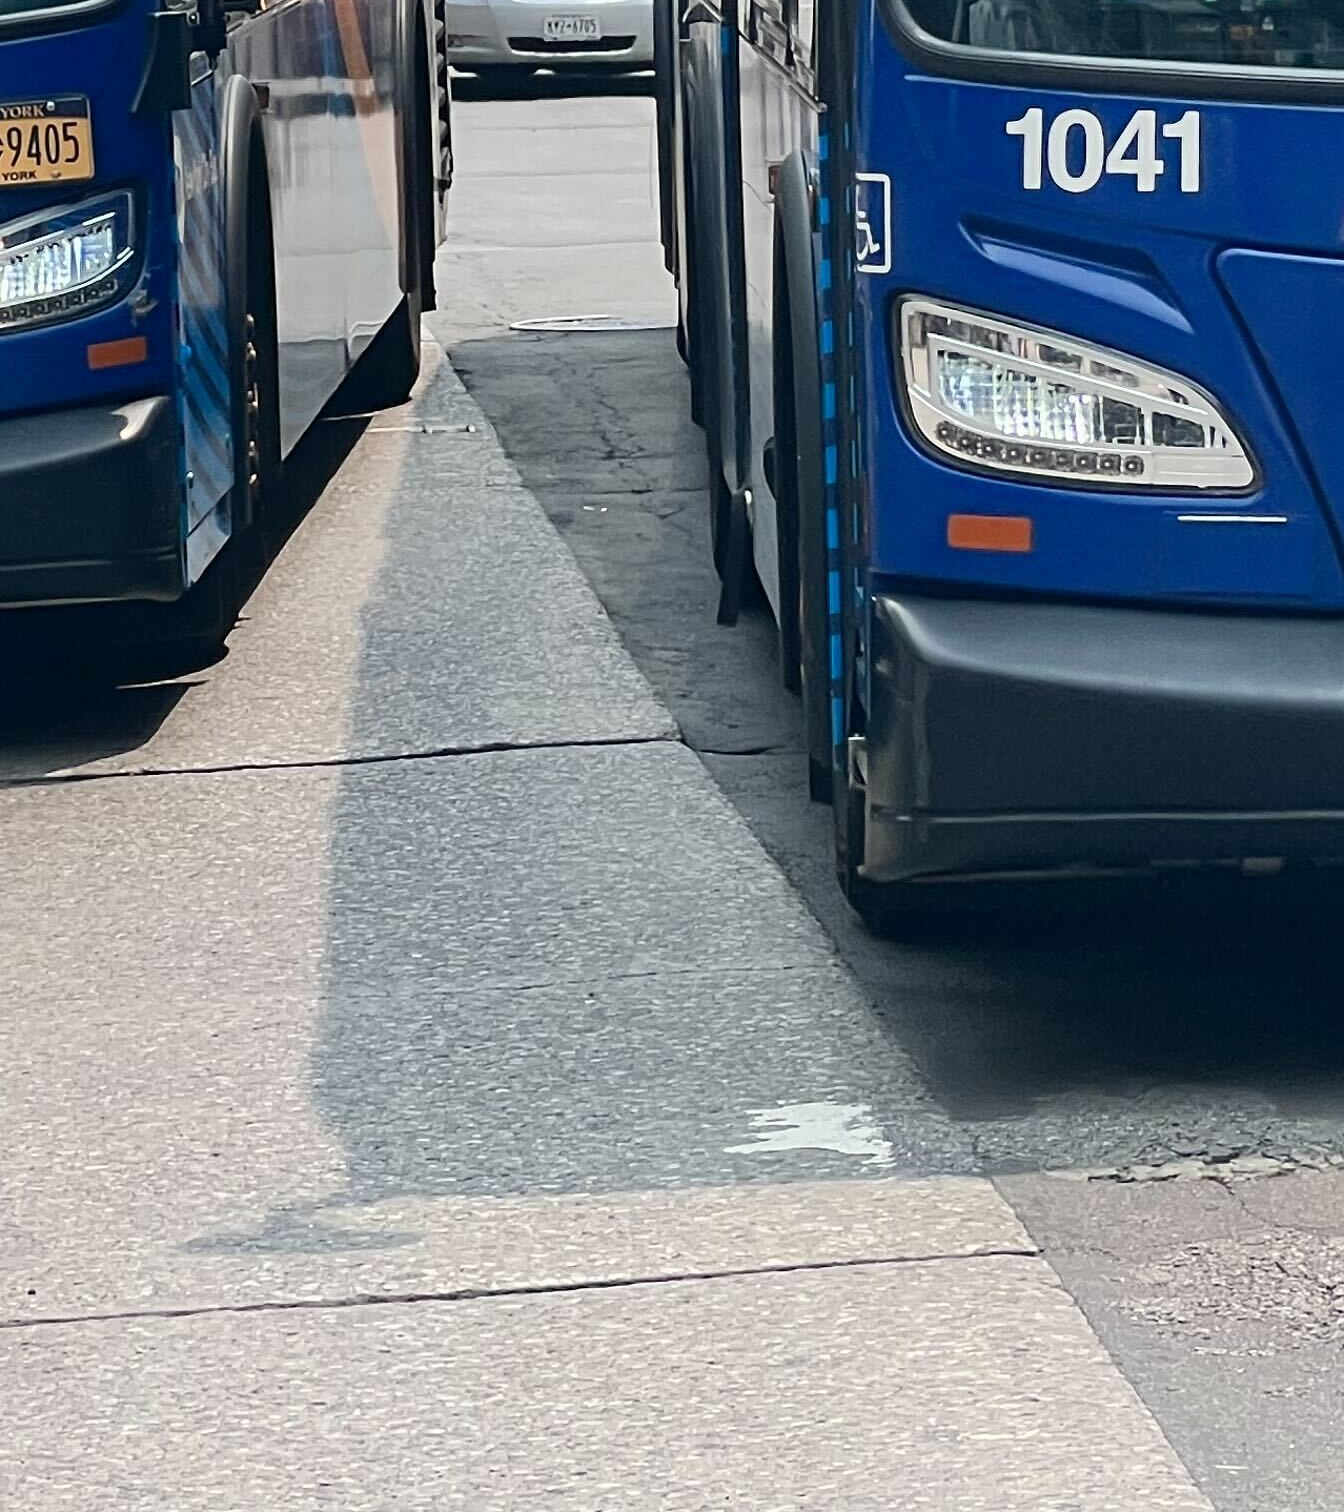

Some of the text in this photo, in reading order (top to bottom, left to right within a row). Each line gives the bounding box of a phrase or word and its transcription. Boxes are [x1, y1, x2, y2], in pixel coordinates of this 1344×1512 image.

[0, 104, 45, 119] YORK
[1005, 106, 1202, 194] 1041
[1, 170, 37, 182] YORK
